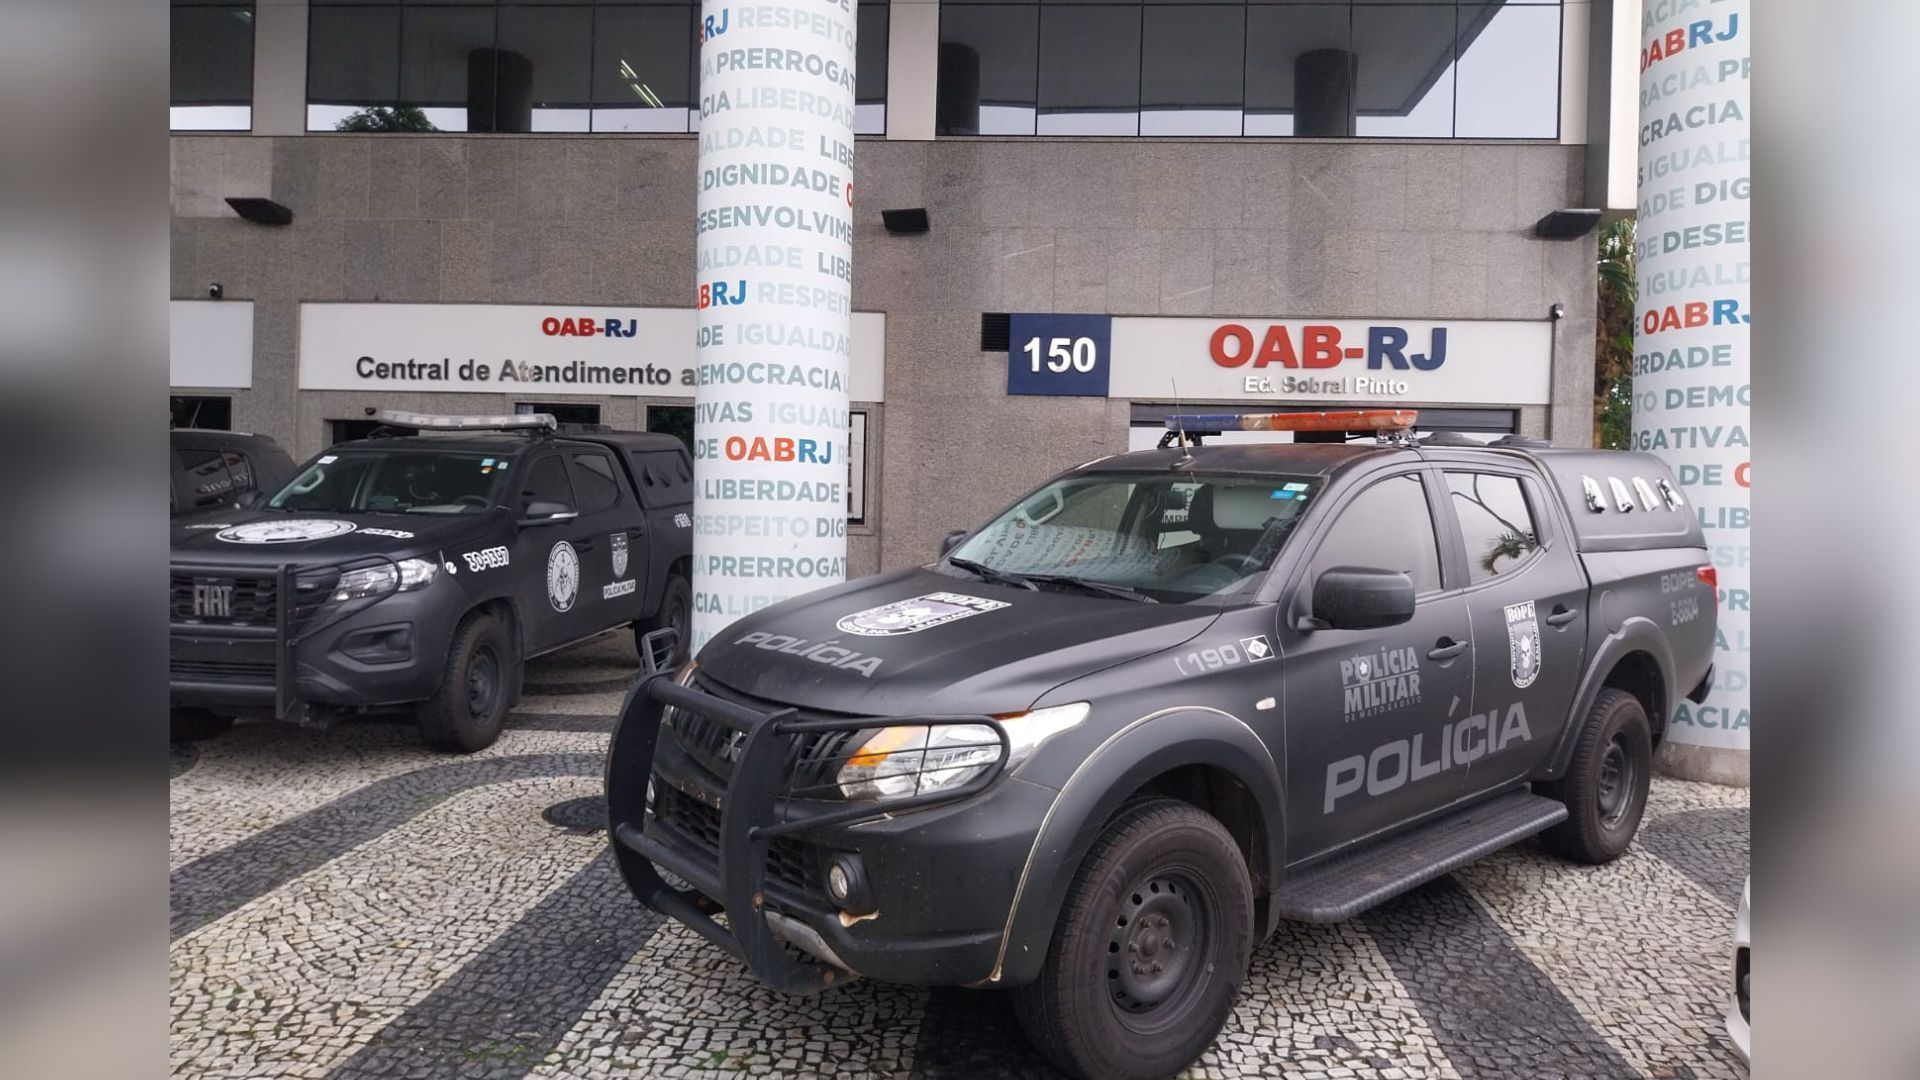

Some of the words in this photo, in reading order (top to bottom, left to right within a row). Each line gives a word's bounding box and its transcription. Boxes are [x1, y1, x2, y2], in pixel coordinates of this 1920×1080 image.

[699, 90, 731, 122] CIA
[1638, 99, 1744, 152] CRACIA
[704, 163, 840, 198] DIGNIDADE
[1663, 221, 1750, 255] DESE
[542, 317, 638, 338] OAB-RJ
[1023, 337, 1097, 374] 150
[1209, 324, 1448, 370] OAB-RJ
[355, 356, 449, 381] Central
[458, 359, 491, 382] de
[498, 359, 672, 385] Atendimento
[1244, 375, 1277, 394] Ed.
[1282, 375, 1347, 395] Sobral
[1355, 377, 1409, 395] Pinto
[725, 435, 832, 466] OABRJ
[705, 478, 840, 504] LIBERDADE
[816, 517, 847, 540] DIG
[708, 555, 847, 578] PRERROGAT
[1661, 571, 1696, 594] BOPE
[194, 585, 234, 618] FIAT
[692, 591, 723, 616] CIA
[1507, 603, 1535, 622] BOPE
[733, 631, 884, 678] POLÍCIA
[1344, 674, 1420, 714] MILITAR
[1324, 694, 1534, 815] POLÍCIA
